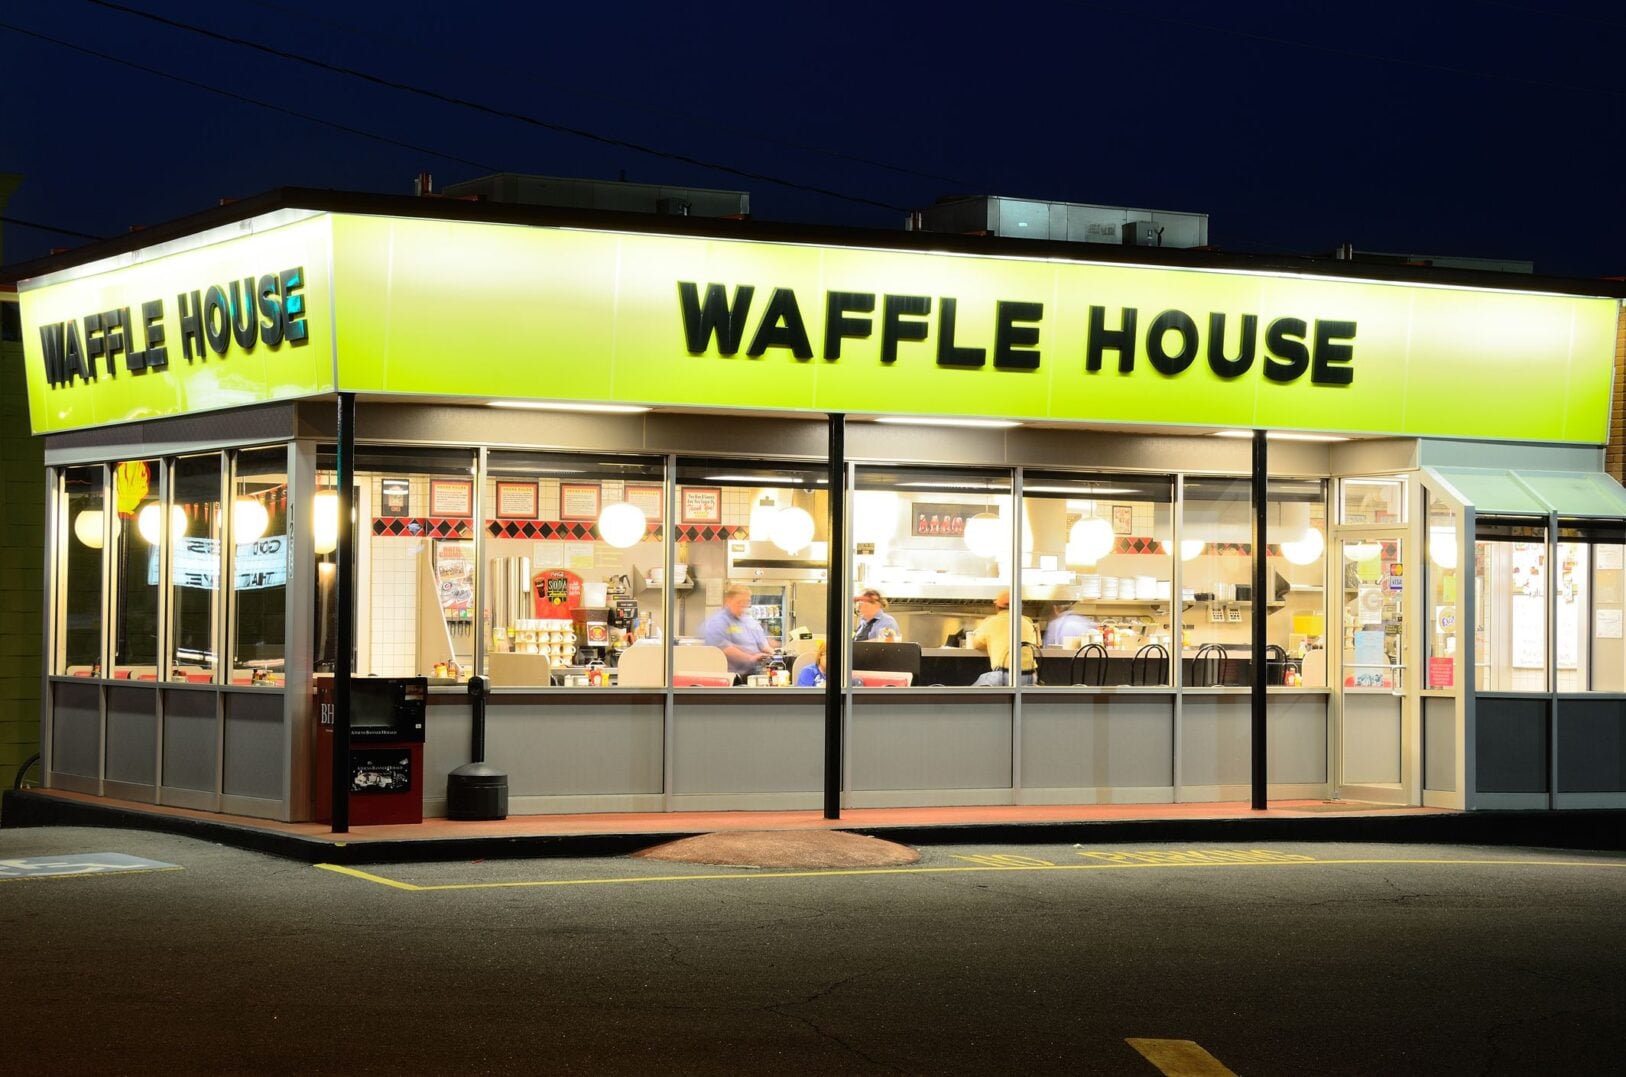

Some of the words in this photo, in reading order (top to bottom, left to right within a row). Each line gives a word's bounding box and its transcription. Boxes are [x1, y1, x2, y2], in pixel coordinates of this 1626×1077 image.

[39, 299, 168, 386] WAFFLE
[177, 266, 309, 362] HOUSE
[677, 280, 1044, 371] WAFFLE
[1085, 304, 1357, 386] HOUSE
